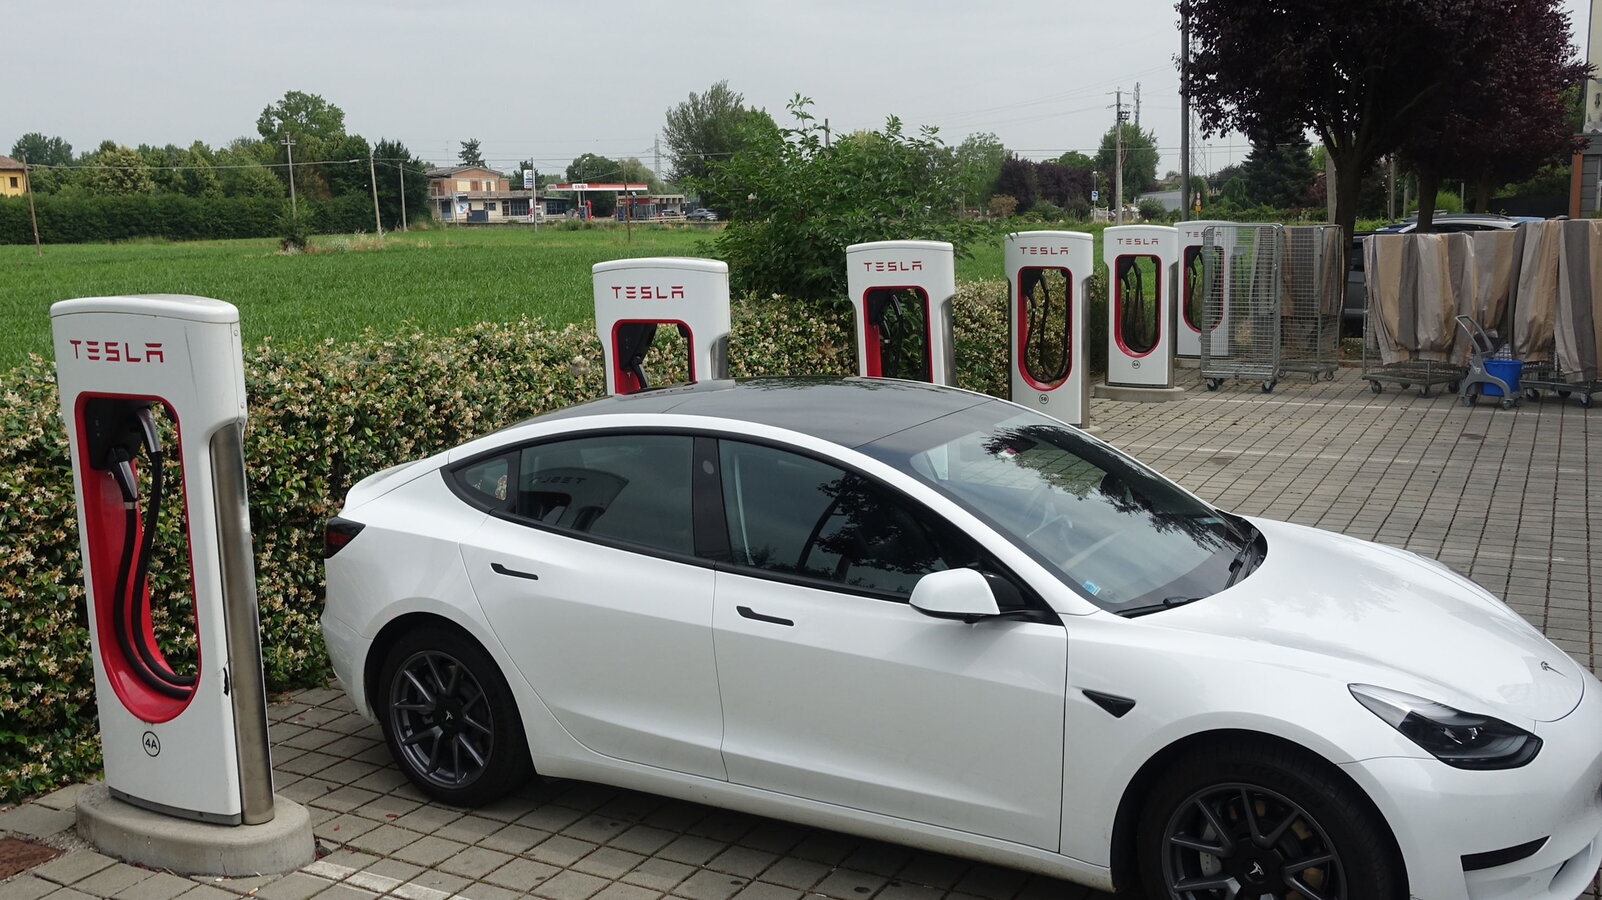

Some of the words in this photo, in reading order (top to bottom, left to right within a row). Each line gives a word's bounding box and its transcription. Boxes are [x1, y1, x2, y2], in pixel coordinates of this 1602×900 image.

[1117, 238, 1159, 246] TESLA
[1019, 246, 1069, 255] TESLA
[863, 260, 922, 272] TESLA
[611, 286, 685, 299] TESLA
[69, 339, 165, 363] TESLA
